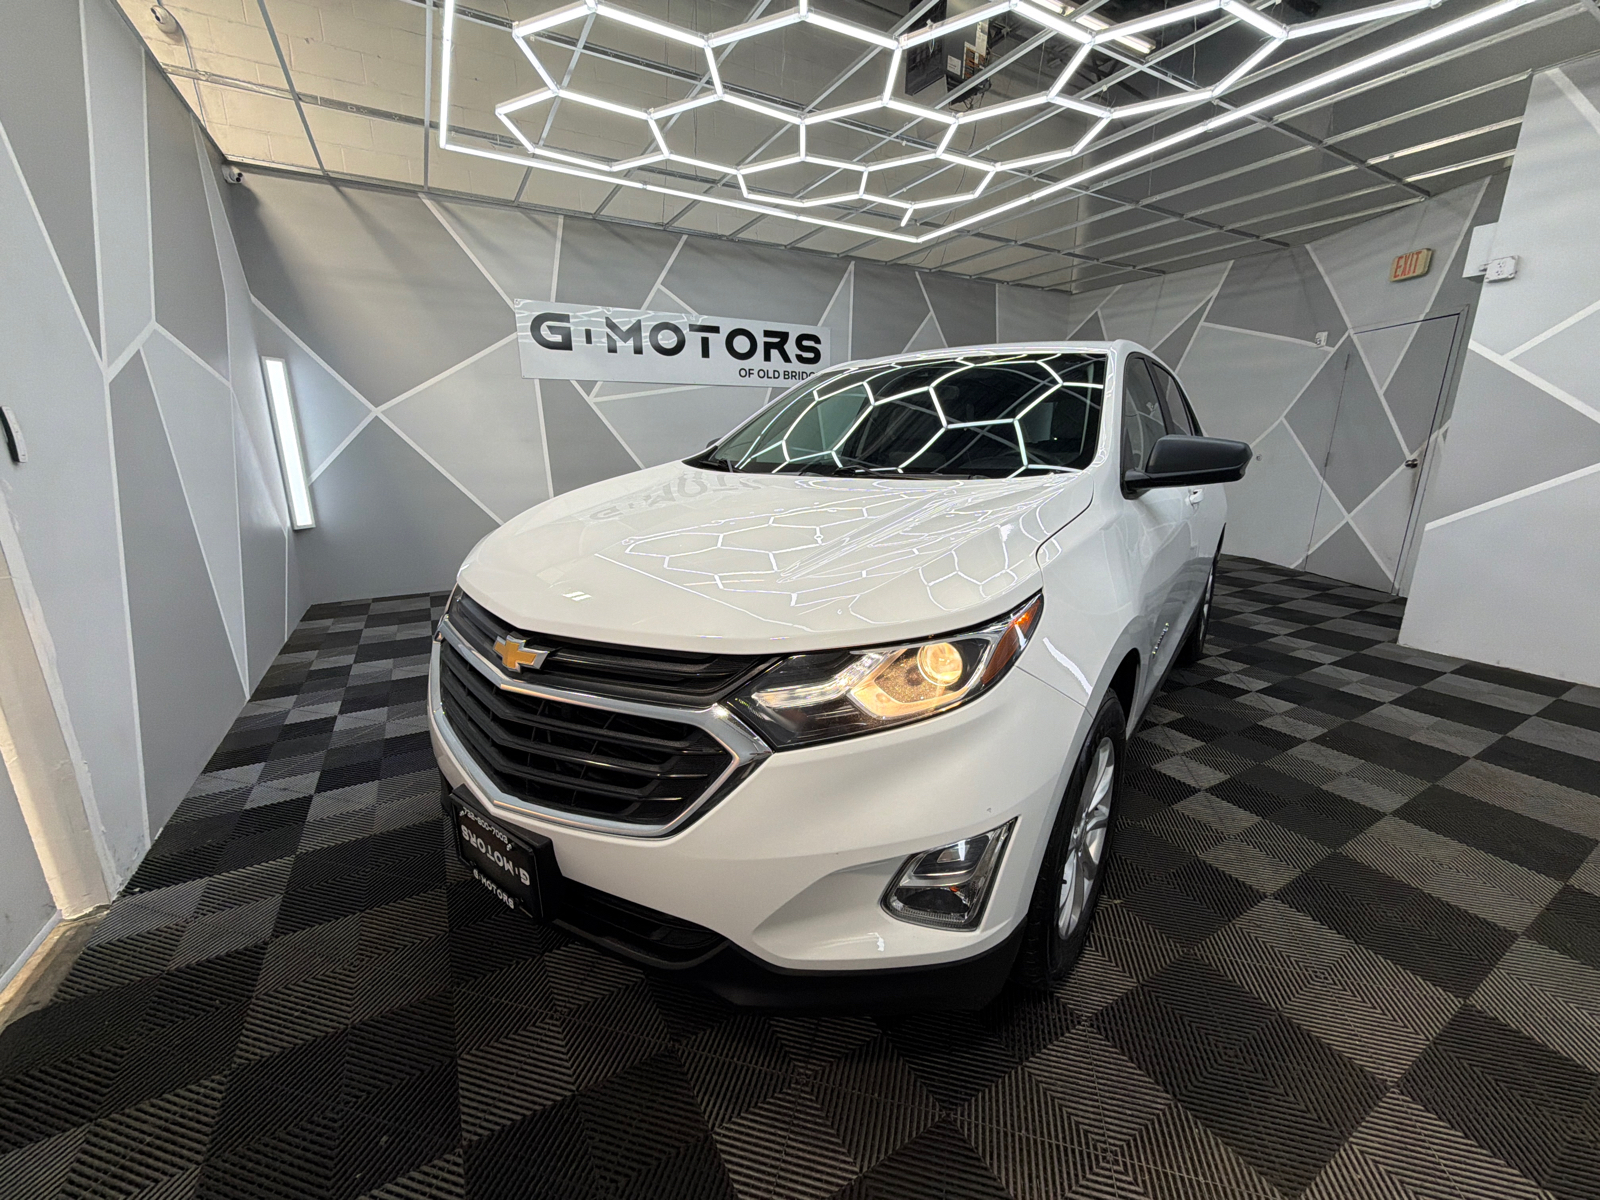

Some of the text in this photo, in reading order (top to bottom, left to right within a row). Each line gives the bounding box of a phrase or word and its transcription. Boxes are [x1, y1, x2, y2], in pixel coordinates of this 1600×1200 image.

[1393, 251, 1422, 279] EXIT
[738, 368, 754, 378] OF
[757, 369, 780, 379] OLD
